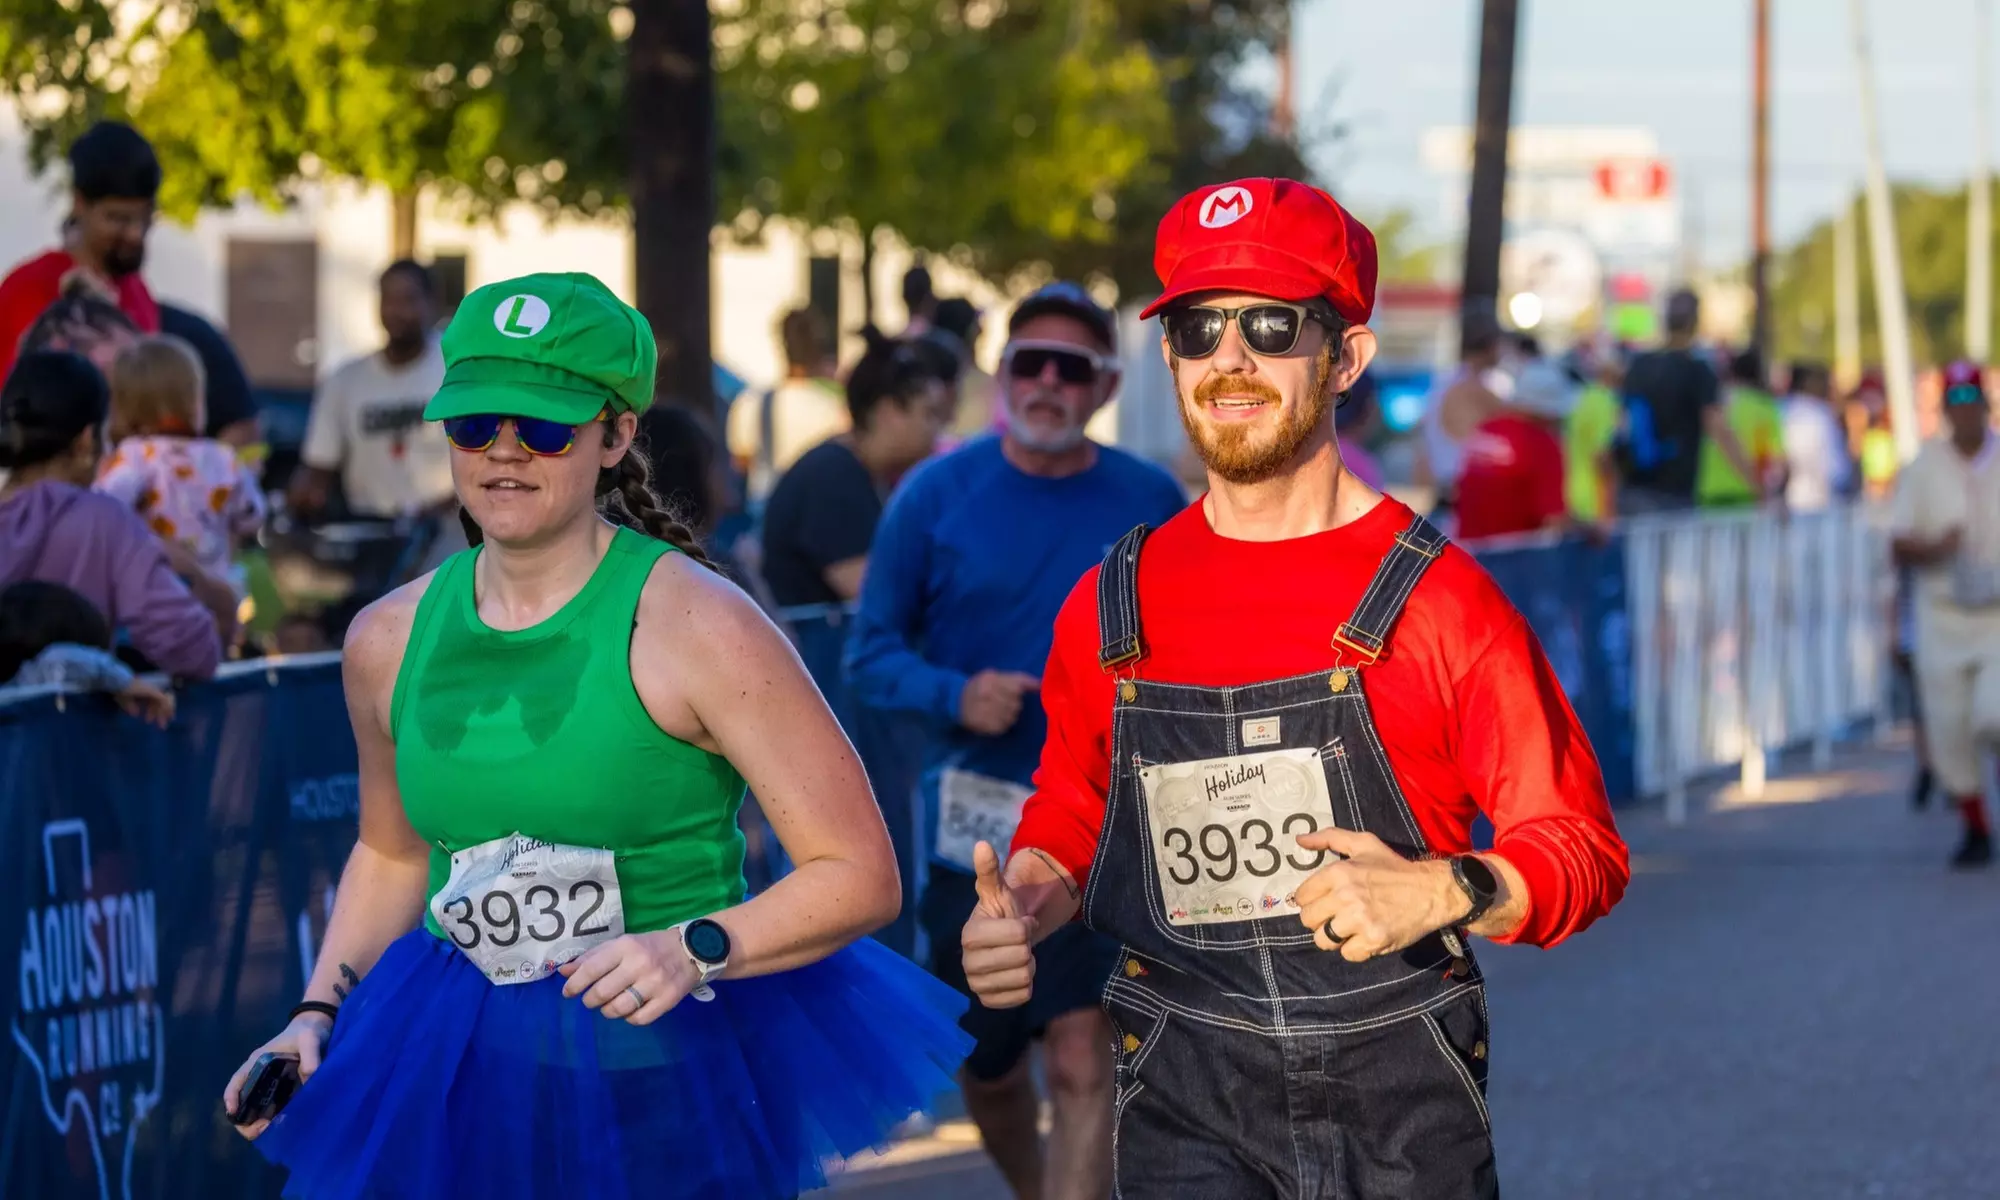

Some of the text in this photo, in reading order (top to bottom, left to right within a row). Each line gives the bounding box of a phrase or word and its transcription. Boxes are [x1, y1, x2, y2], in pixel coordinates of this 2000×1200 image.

[1205, 191, 1247, 224] M
[503, 296, 533, 335] L
[1205, 764, 1266, 801] Holiday
[1163, 812, 1326, 885] 3933
[443, 880, 609, 949] 3932
[20, 890, 157, 1011] HOUSTON
[46, 999, 150, 1081] RUNNING
